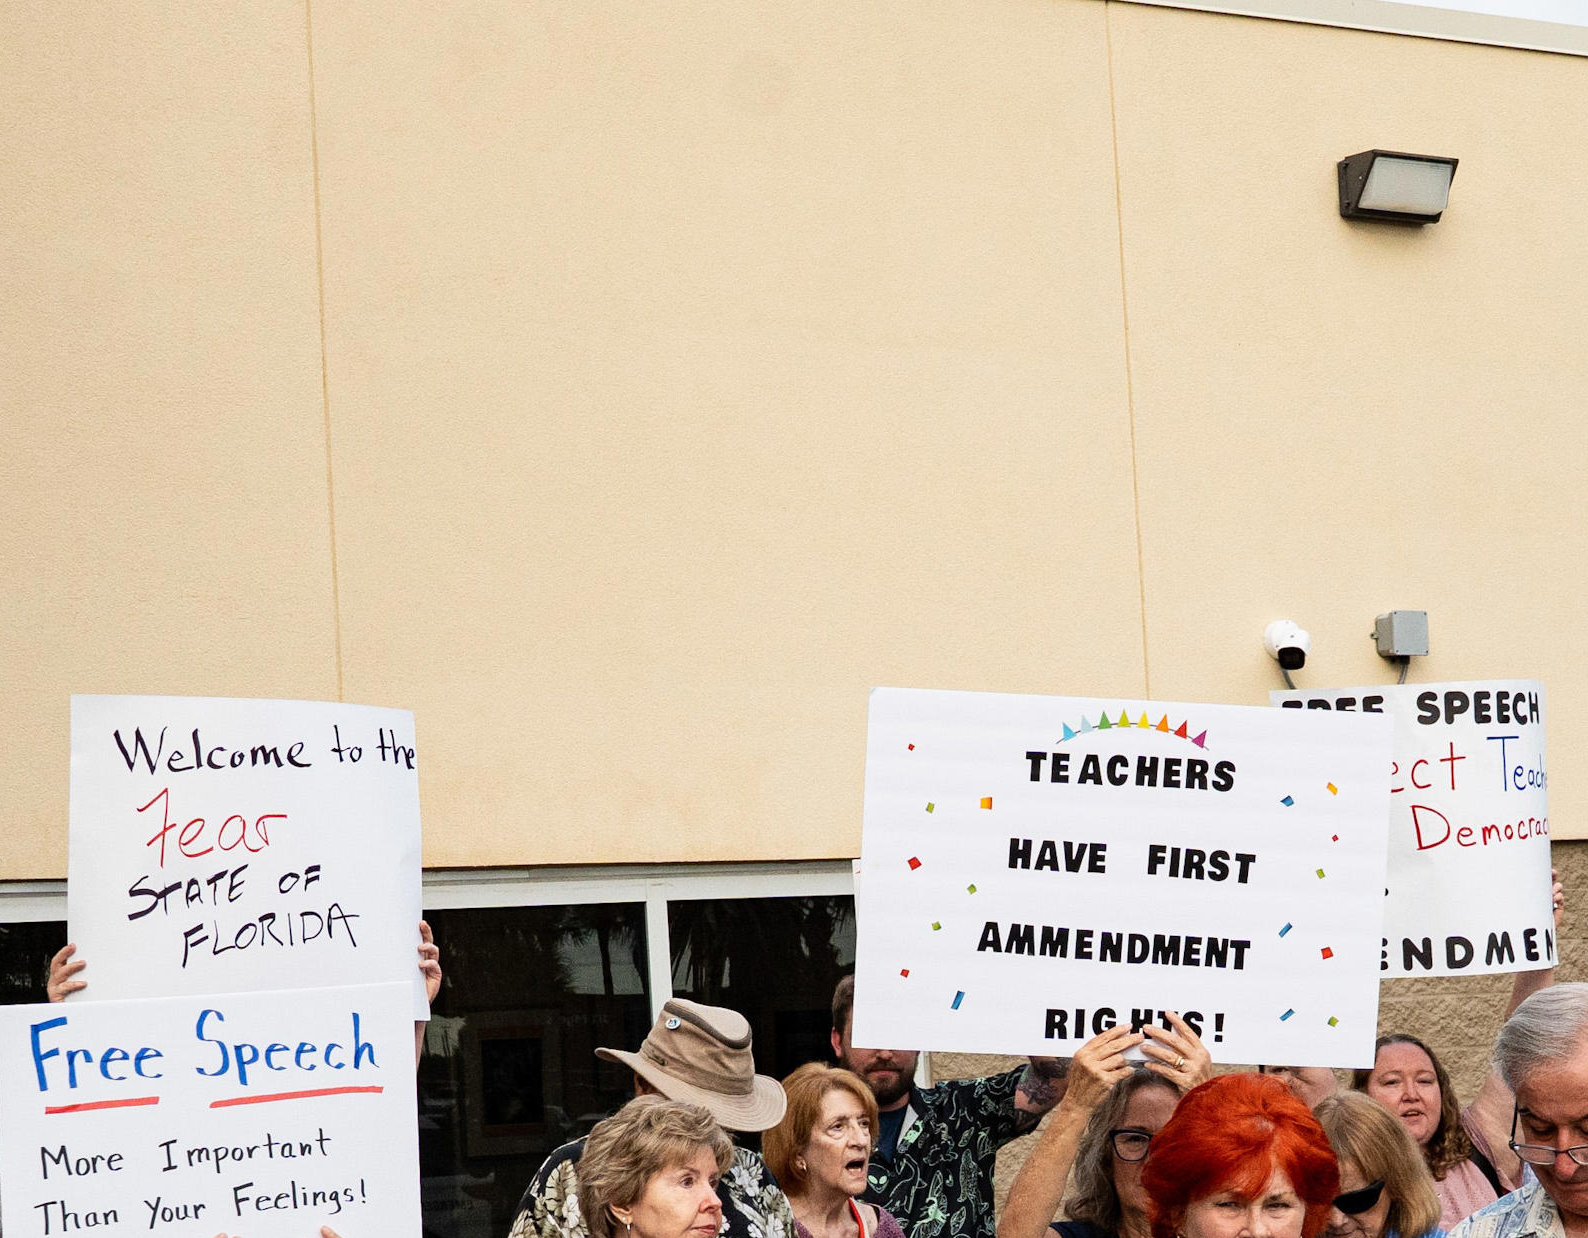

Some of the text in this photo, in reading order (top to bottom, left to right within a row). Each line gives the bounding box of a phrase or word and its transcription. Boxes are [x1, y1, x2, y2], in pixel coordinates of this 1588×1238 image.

[1416, 690, 1540, 726] SPEECH
[113, 724, 415, 776] Welcome to the
[1024, 750, 1238, 793] TEACHERS
[1008, 837, 1256, 885] HAVE FIRST
[127, 863, 321, 921] STATE OF
[180, 902, 360, 969] FLORIDA
[977, 920, 1251, 971] AMMENDMENT
[29, 1008, 381, 1092] Free Speech
[40, 1127, 332, 1181] More Important
[35, 1178, 369, 1236] Than Your Feelings!
